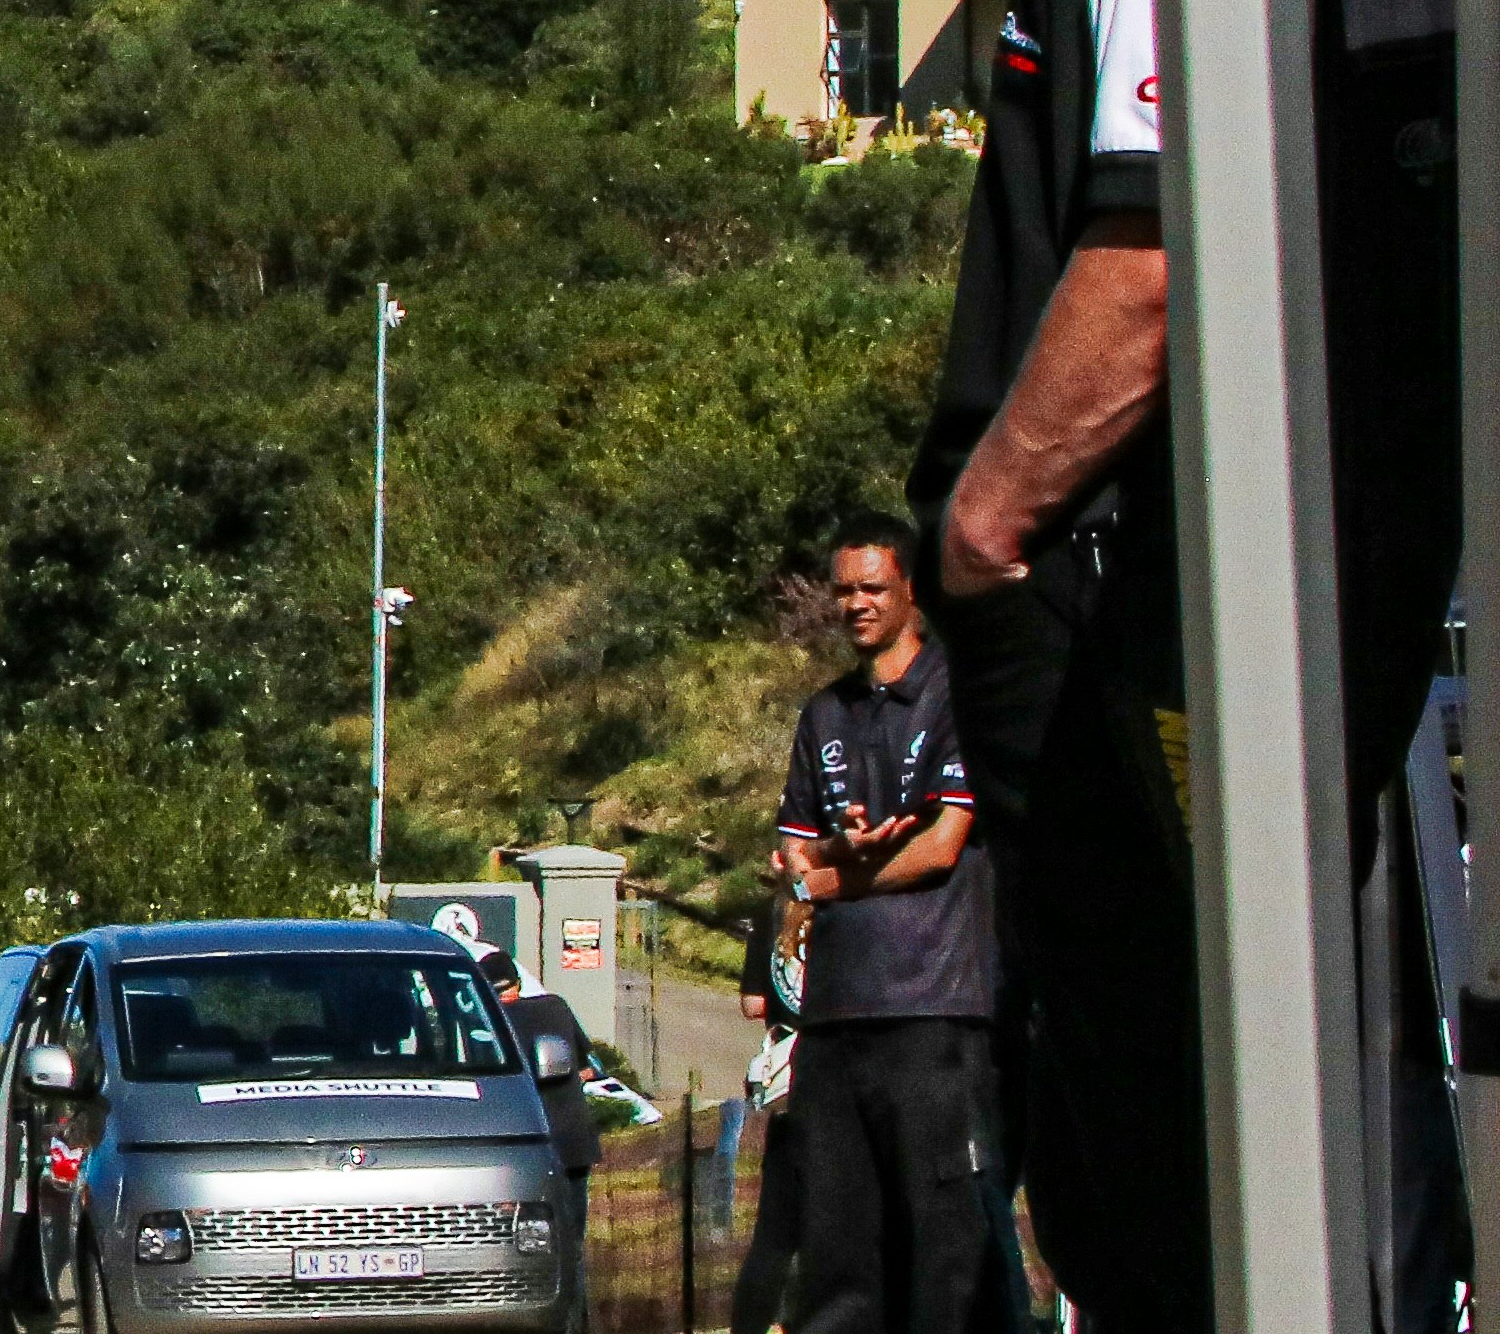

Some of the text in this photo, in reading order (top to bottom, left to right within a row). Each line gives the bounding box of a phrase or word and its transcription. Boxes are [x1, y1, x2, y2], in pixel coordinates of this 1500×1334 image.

[235, 1081, 443, 1095] MEDIA SHUTTLE
[329, 1254, 349, 1274] 52
[361, 1254, 379, 1273] YS
[398, 1253, 419, 1273] GP
